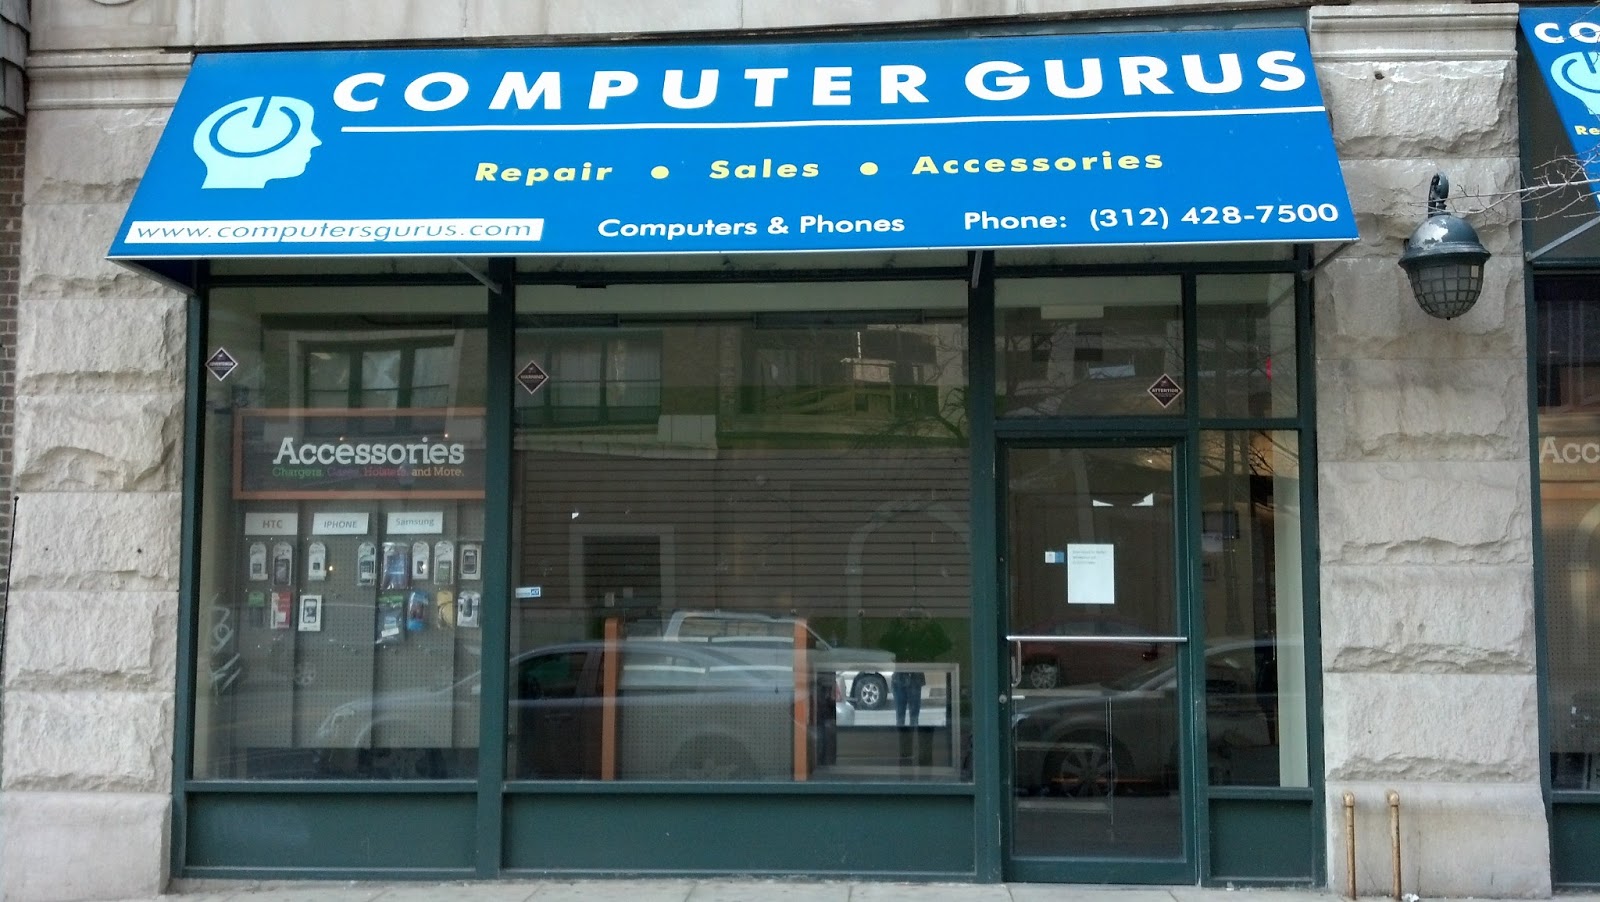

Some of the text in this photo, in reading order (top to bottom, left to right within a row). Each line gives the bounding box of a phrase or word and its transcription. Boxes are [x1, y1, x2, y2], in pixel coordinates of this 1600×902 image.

[333, 50, 1307, 112] COMPUTER GURUS
[475, 151, 1164, 186] Repair Sales Accessories
[598, 215, 905, 240] Computers & Phones
[964, 203, 1339, 231] Phone: (312) 428-7500
[136, 221, 532, 242] www.computersgurus.com
[272, 436, 465, 465] Accessories
[1539, 436, 1600, 464] Acc
[411, 467, 431, 476] and
[433, 467, 465, 477] More.
[262, 519, 283, 529] HTC
[323, 520, 358, 529] IPHONE
[395, 517, 434, 528] Samsung
